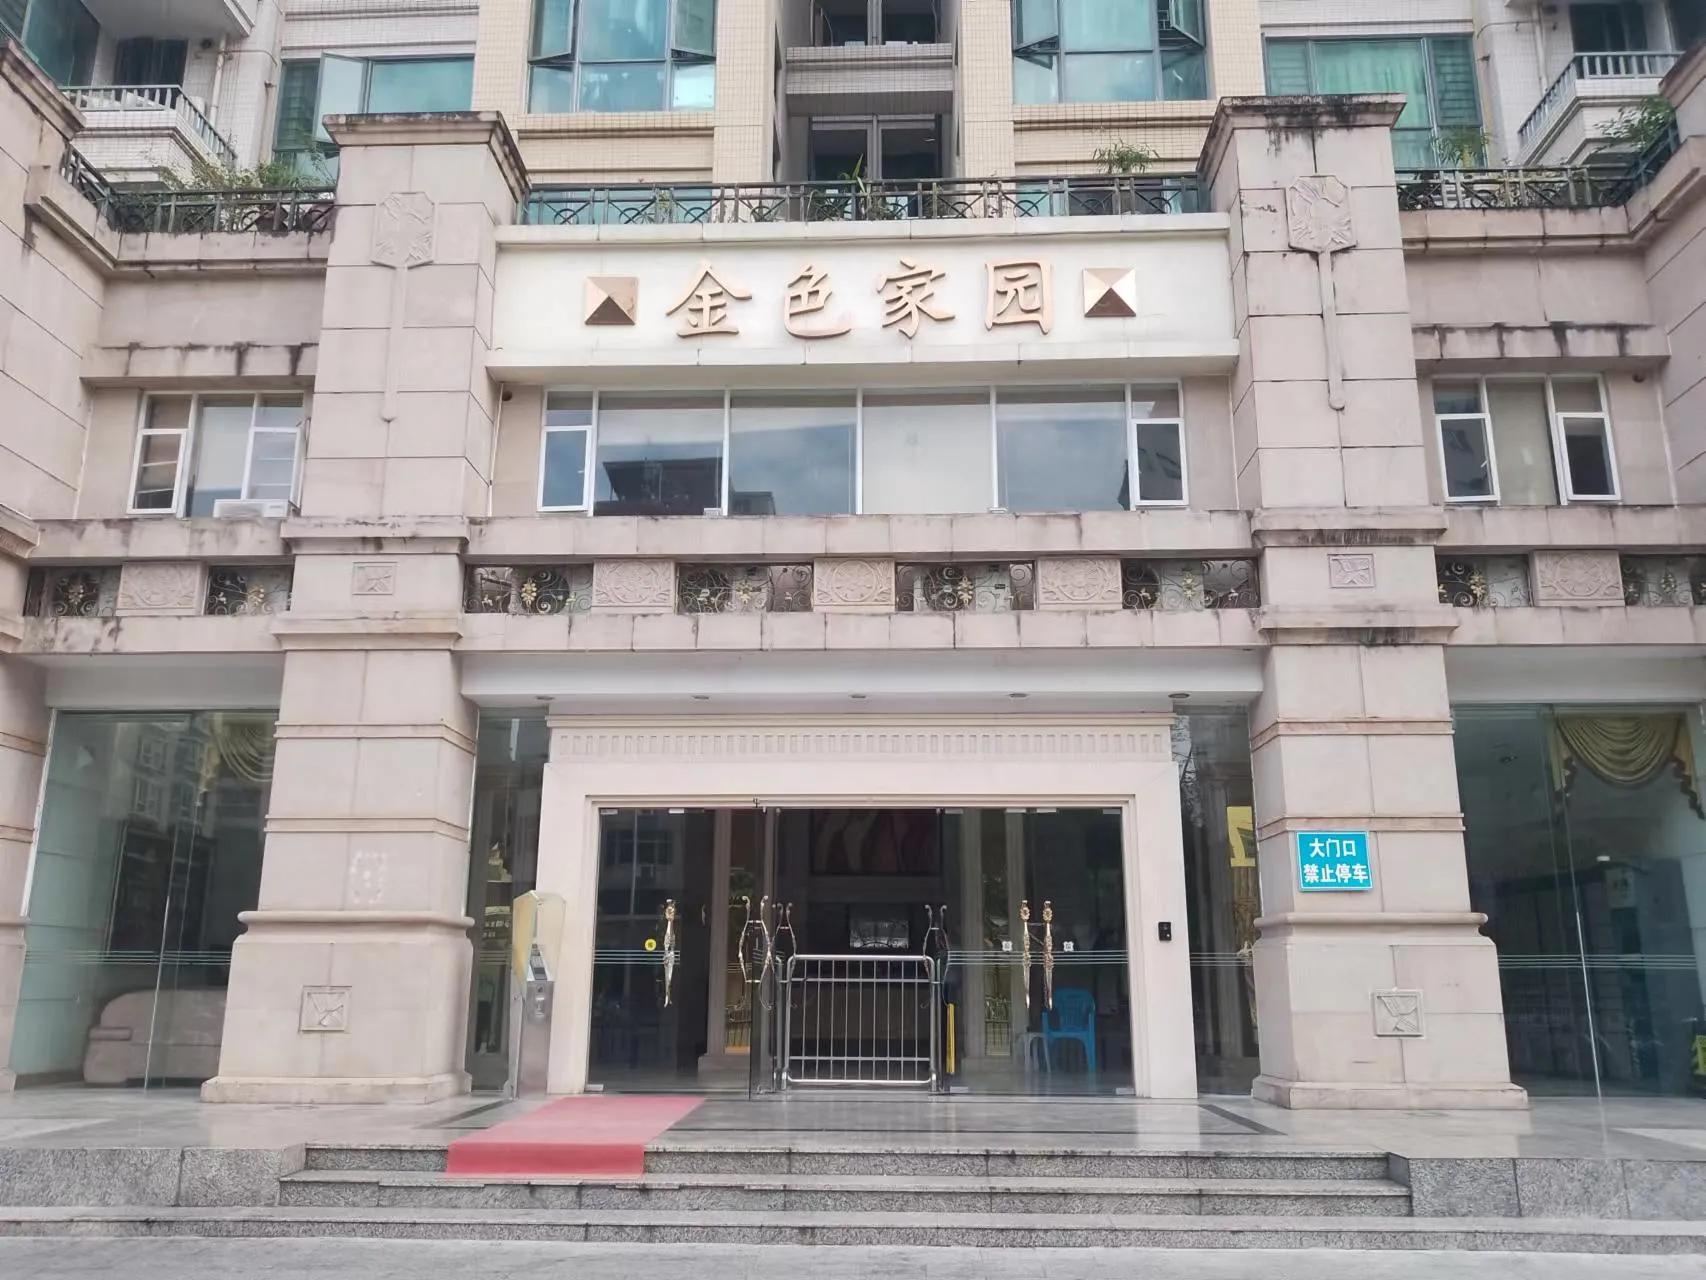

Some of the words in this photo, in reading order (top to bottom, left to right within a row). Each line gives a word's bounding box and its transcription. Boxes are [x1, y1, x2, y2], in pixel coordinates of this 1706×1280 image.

[666, 257, 1055, 339] 金色家园
[1309, 838, 1357, 858] 大门口
[1303, 863, 1369, 884] 禁止停车
